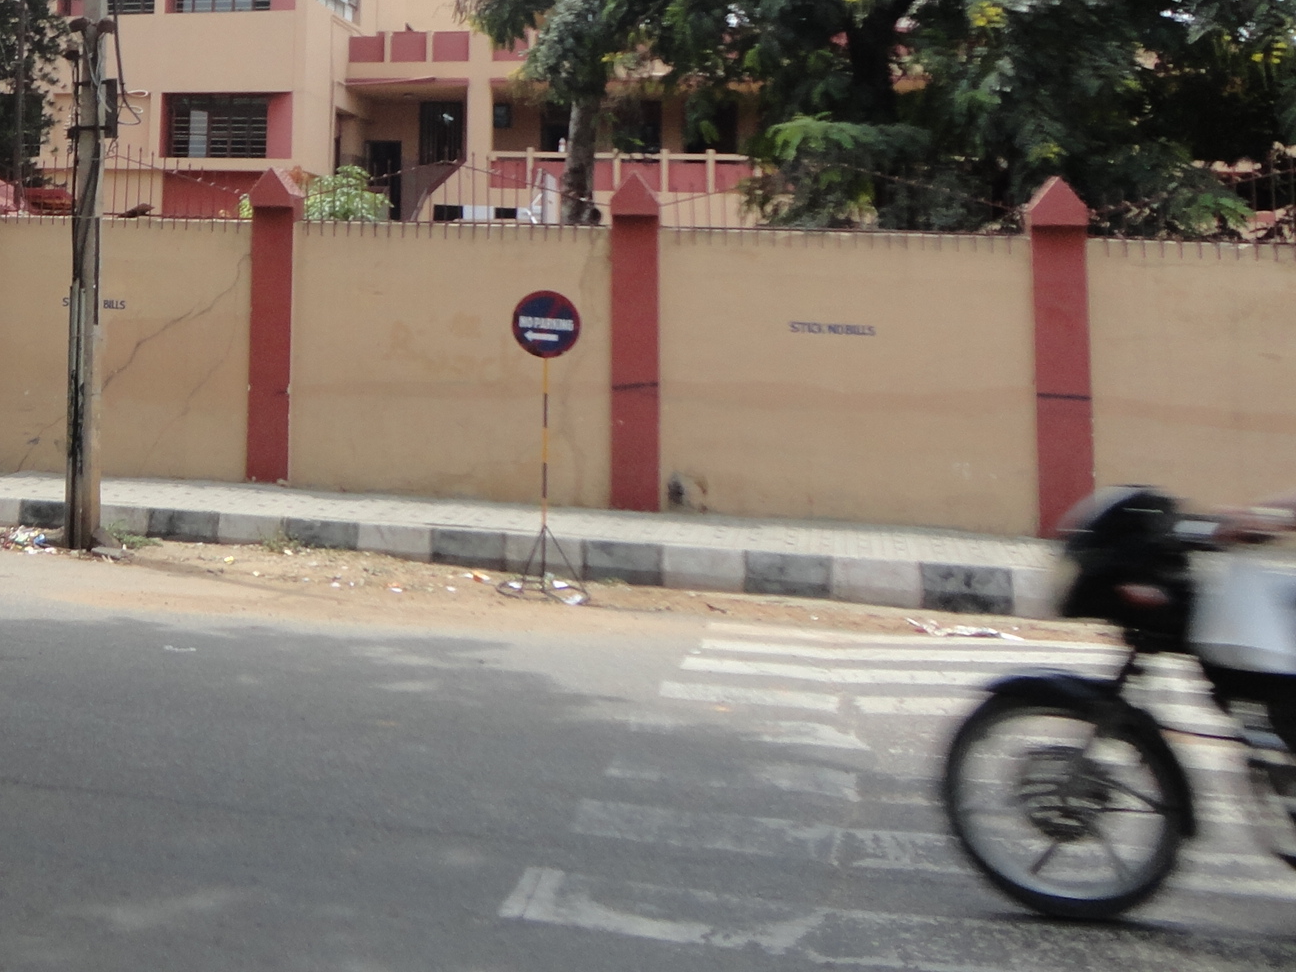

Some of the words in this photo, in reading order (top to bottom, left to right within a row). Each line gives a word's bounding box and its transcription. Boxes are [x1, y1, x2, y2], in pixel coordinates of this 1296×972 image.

[103, 299, 126, 310] BILLS
[518, 315, 534, 328] NO
[534, 317, 574, 331] PARKING
[828, 323, 844, 335] NO
[845, 324, 876, 336] BILLS
